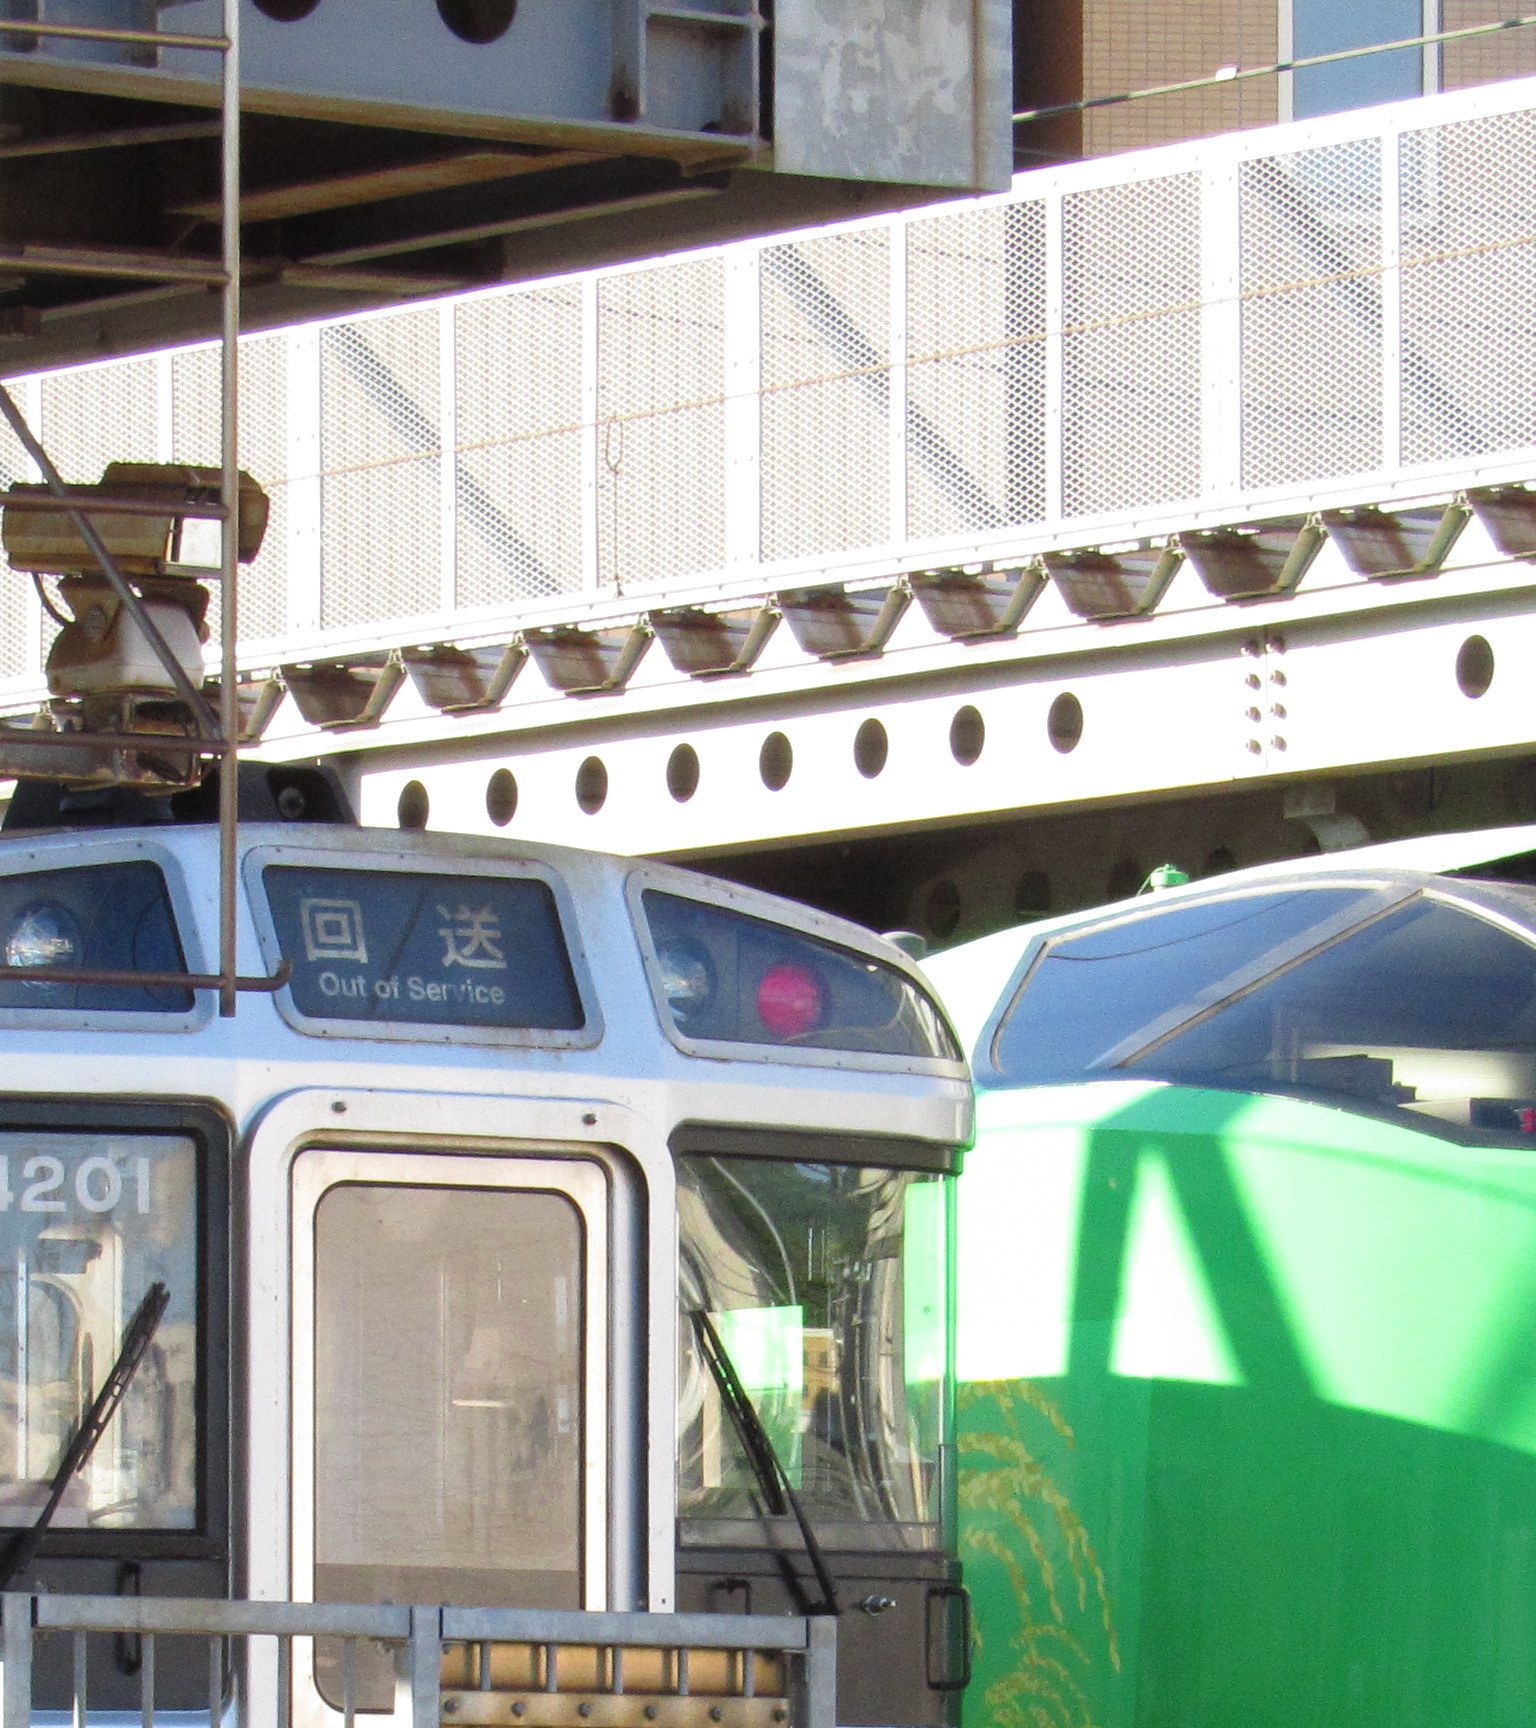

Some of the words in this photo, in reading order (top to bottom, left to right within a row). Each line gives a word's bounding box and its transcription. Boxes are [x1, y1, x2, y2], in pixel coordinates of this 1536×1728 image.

[301, 898, 508, 969] 回送
[319, 971, 366, 999] Out
[376, 977, 401, 1000] of
